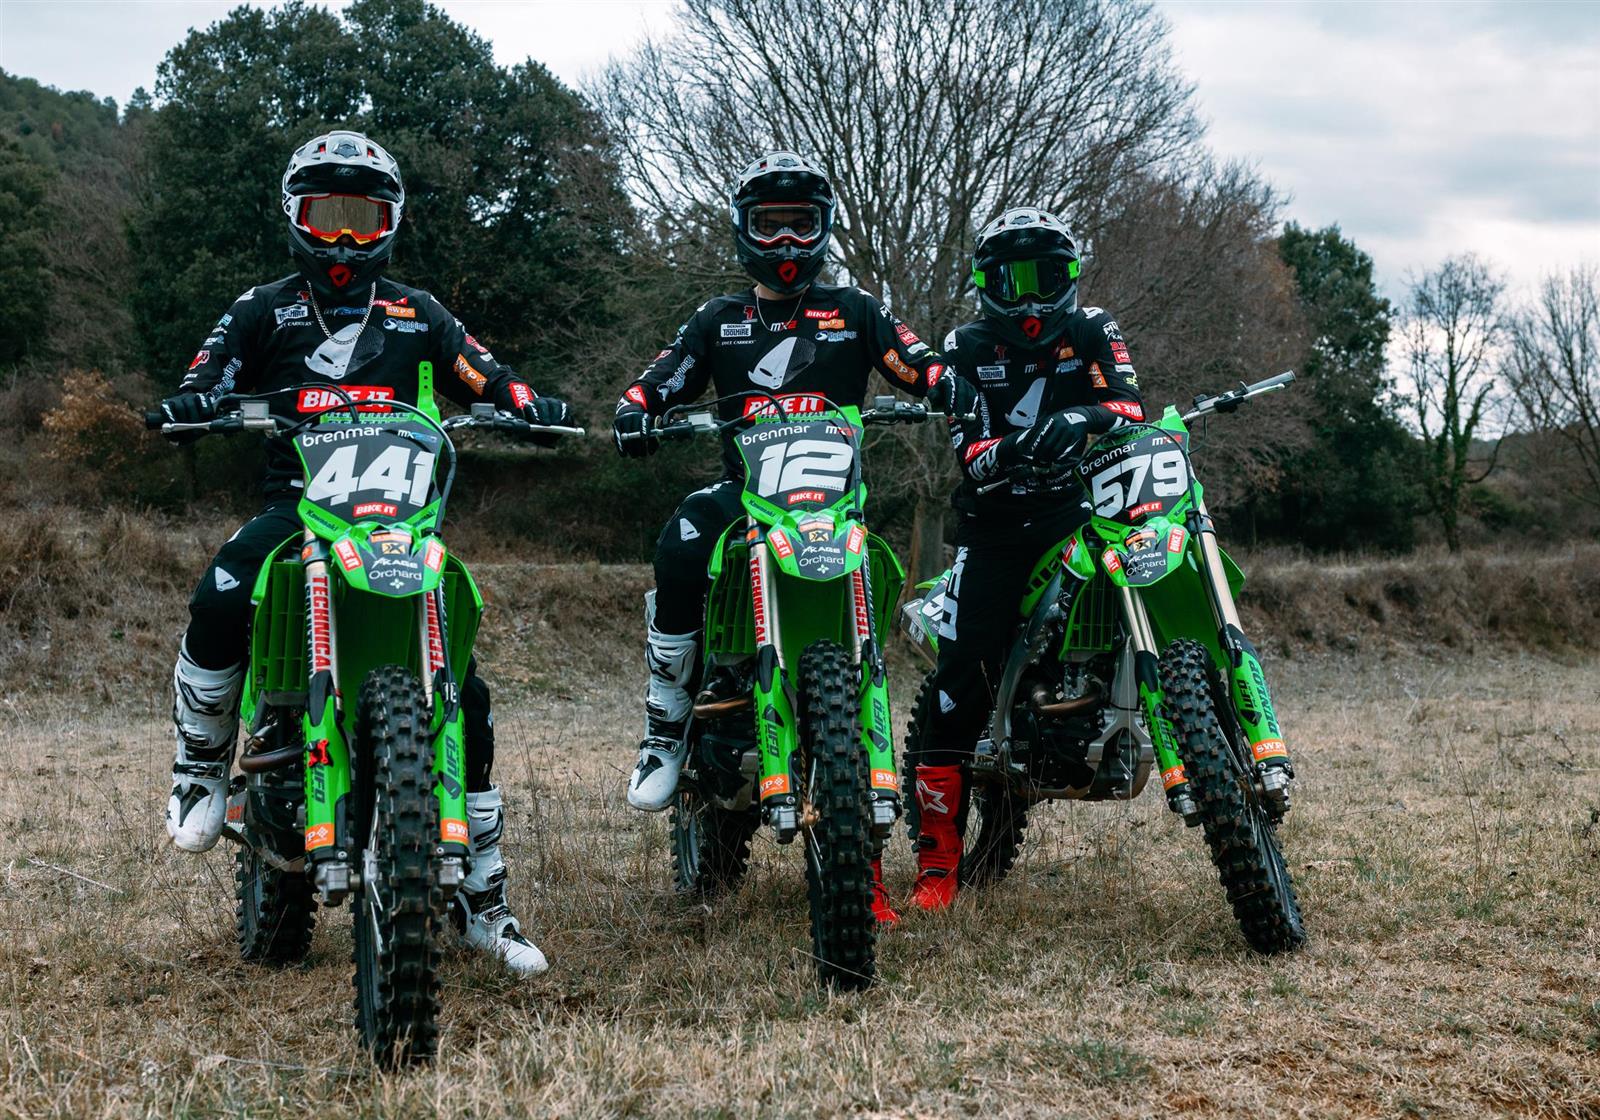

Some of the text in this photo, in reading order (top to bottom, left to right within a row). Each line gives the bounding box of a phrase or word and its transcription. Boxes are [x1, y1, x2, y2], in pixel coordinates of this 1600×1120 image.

[800, 397, 820, 412] IT
[302, 427, 384, 447] brenmar
[742, 425, 811, 445] brenmar
[1080, 442, 1138, 475] brenmar
[306, 444, 436, 508] 441
[757, 440, 854, 498] 12
[1091, 450, 1188, 519] 579
[790, 493, 812, 502] BIKE
[356, 504, 396, 514] BIKE IT
[1131, 502, 1161, 516] BIKE IT
[799, 555, 844, 567] Orchard
[1126, 559, 1166, 576] Orchard
[369, 568, 422, 580] Orchard
